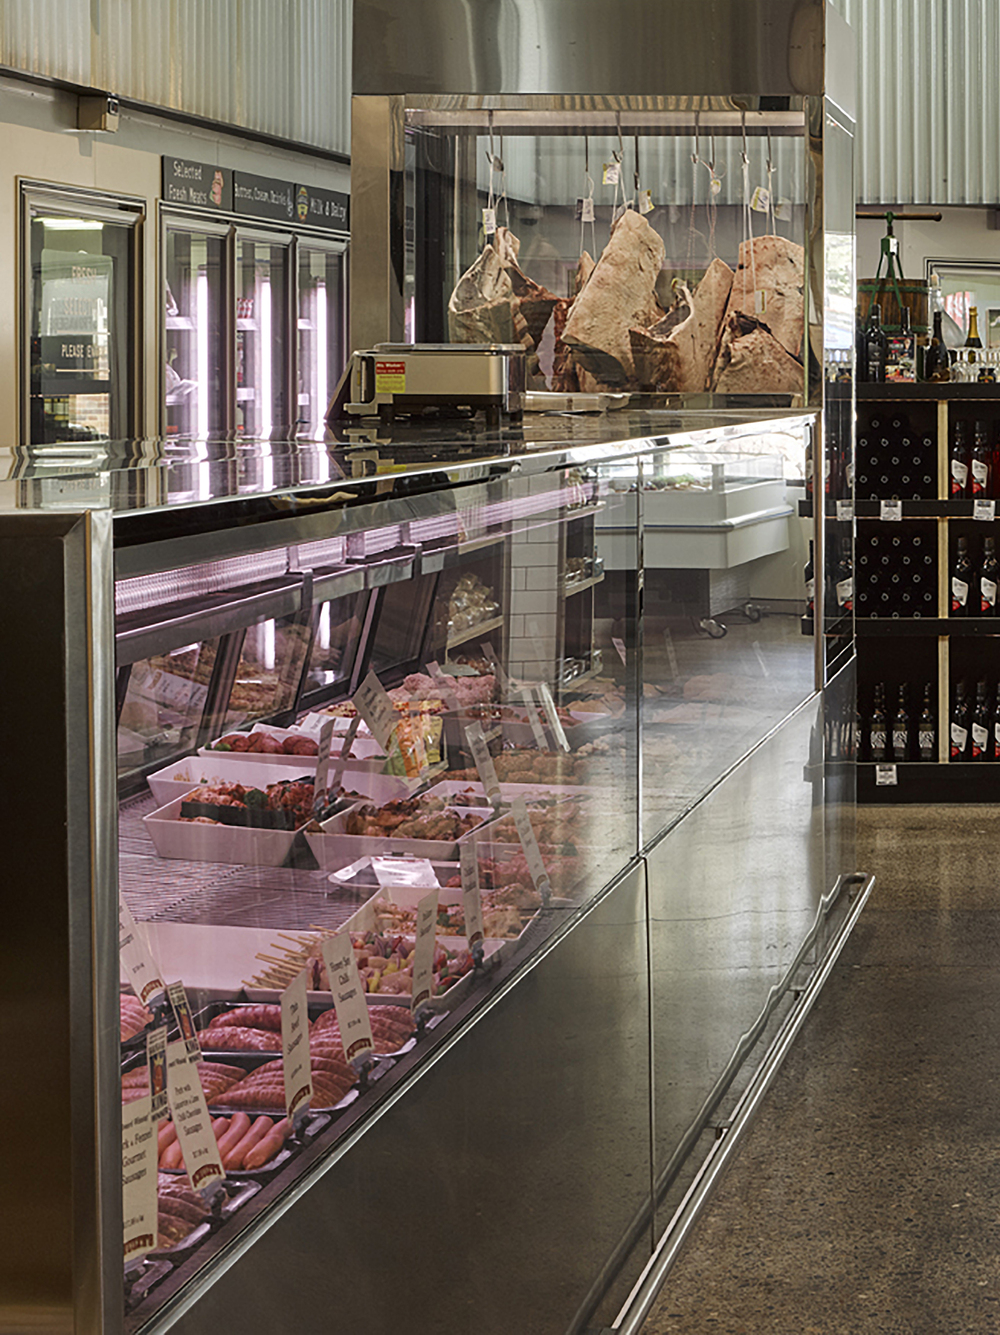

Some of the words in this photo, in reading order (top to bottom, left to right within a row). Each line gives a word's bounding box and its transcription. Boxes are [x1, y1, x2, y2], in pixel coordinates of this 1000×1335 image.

[172, 160, 203, 181] Selected
[168, 184, 187, 202] Fresh
[188, 187, 208, 205] Meats
[310, 197, 324, 215] Milk
[330, 202, 347, 223] Dairy
[61, 344, 85, 359] PLEASE
